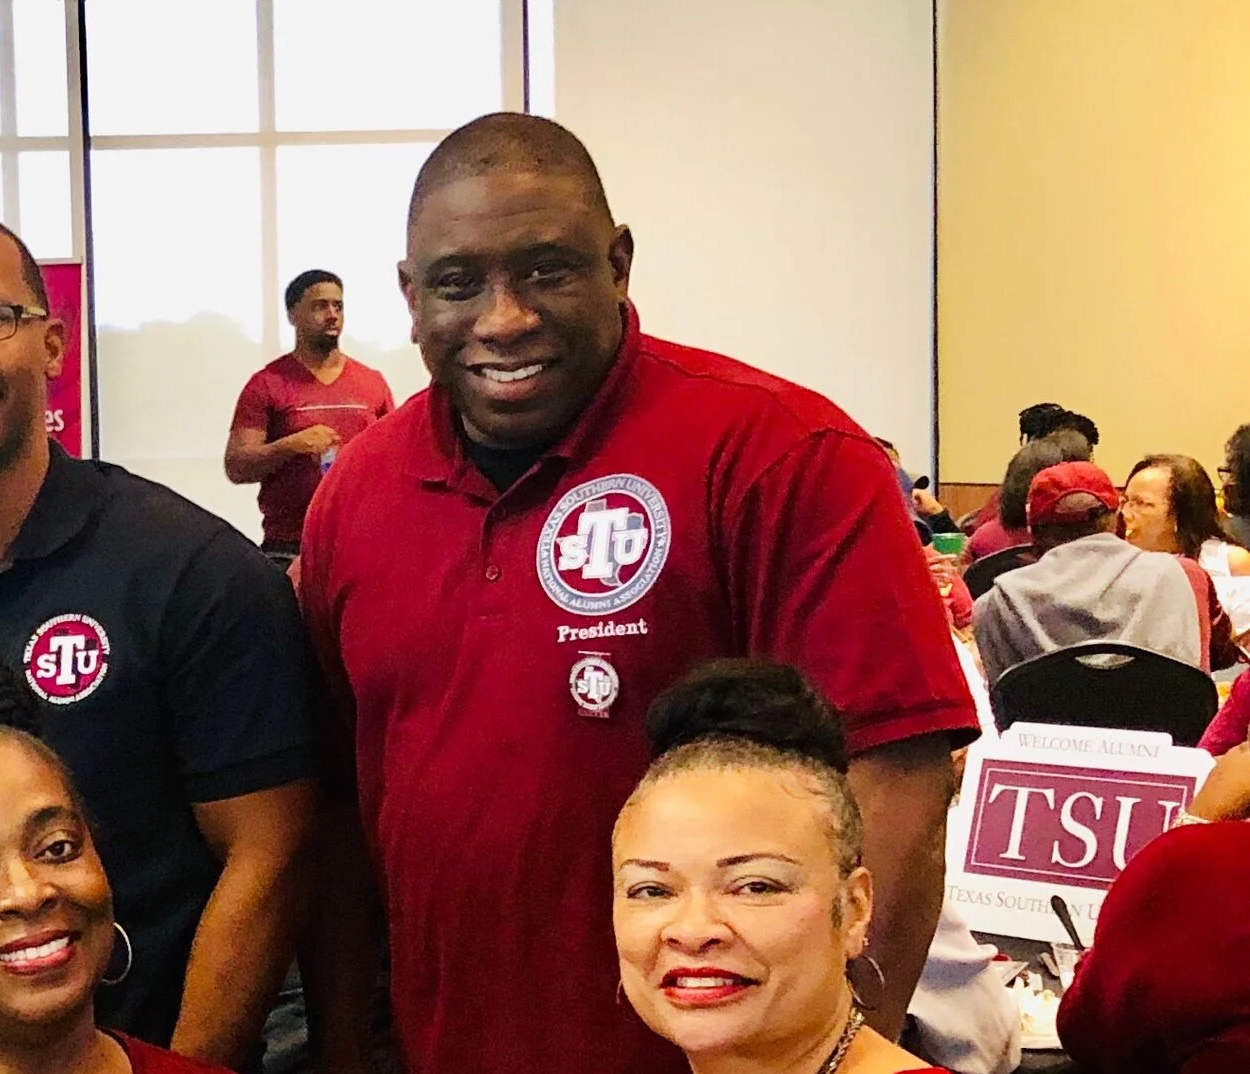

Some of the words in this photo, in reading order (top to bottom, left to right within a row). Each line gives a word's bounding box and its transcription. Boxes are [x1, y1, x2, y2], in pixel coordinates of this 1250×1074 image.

[540, 510, 563, 552] TEXAS
[560, 478, 626, 513] SOUTHERN
[625, 478, 667, 539] UNIVERSITY
[613, 547, 663, 606] ASSOCIATION
[557, 618, 649, 643] President
[1017, 732, 1092, 753] WELCOME
[1097, 739, 1160, 759] ALUMNI
[988, 782, 1183, 873] TSU
[947, 884, 993, 907] TEXAS
[995, 890, 1085, 918] SOUTHN
